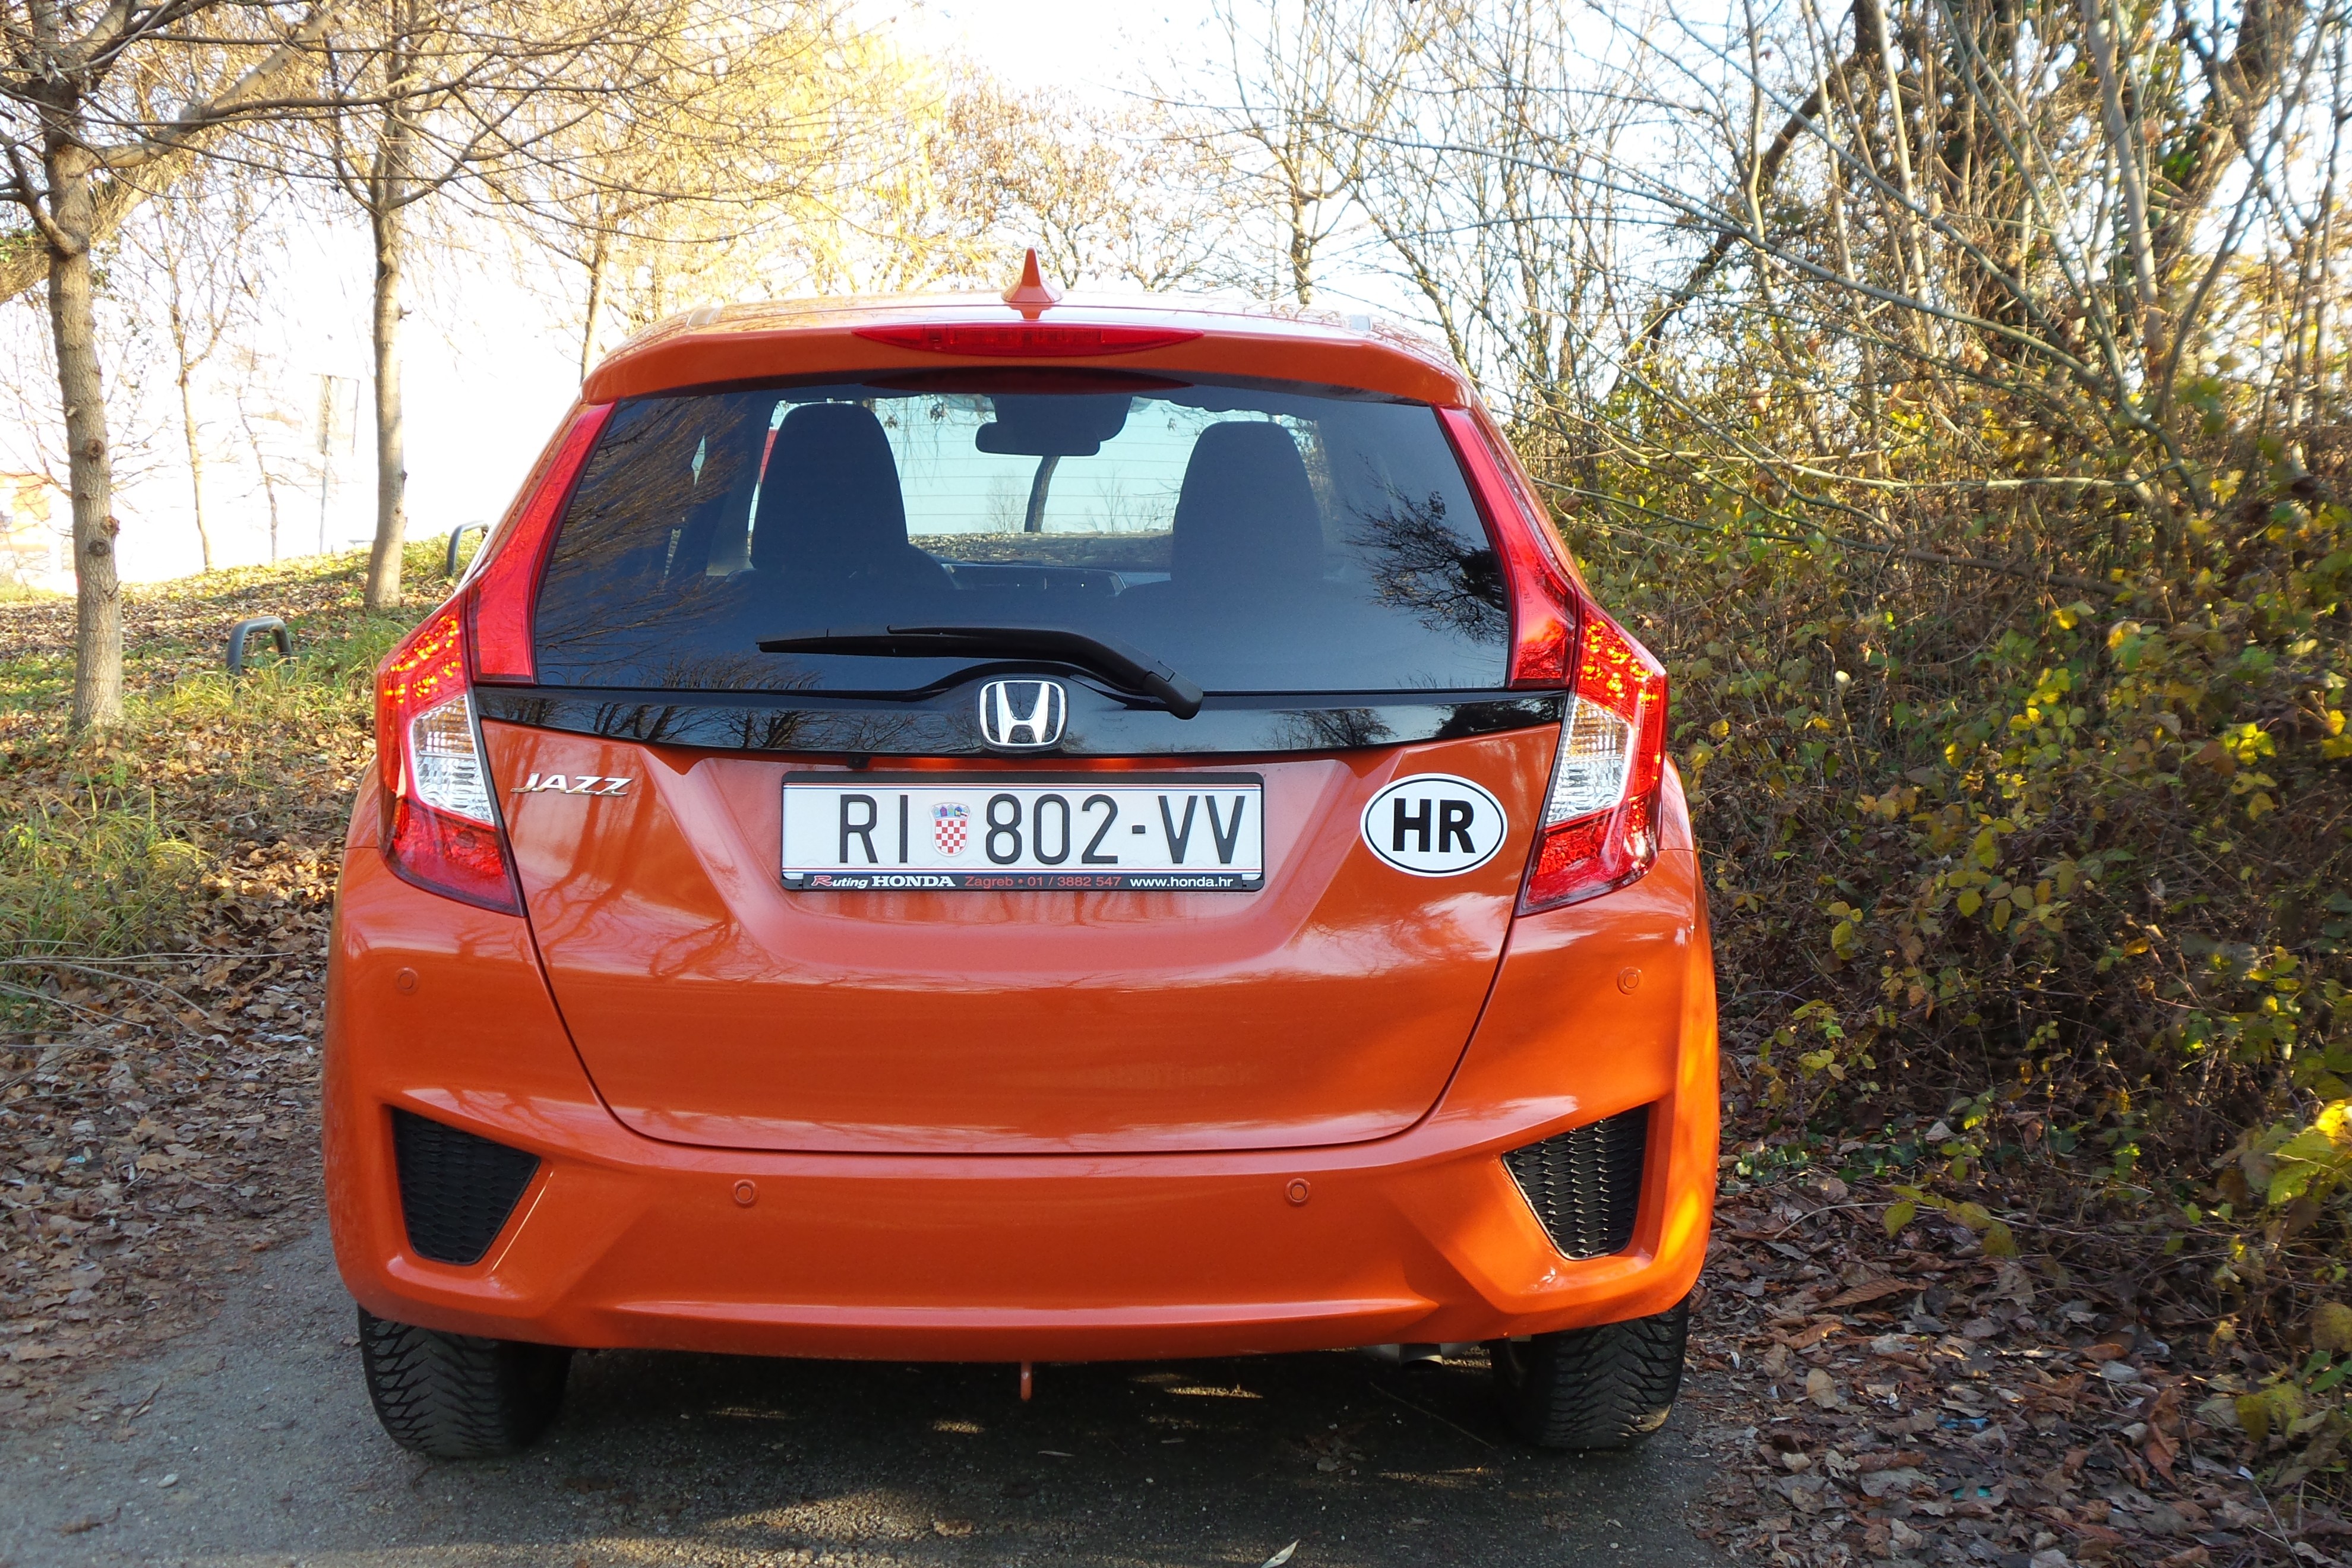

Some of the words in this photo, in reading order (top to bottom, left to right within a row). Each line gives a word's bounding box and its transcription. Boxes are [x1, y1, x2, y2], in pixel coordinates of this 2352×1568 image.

[510, 773, 633, 796] JAZZ
[839, 794, 908, 863] RI
[986, 794, 1245, 864] 802-VV
[1392, 798, 1477, 853] HR
[811, 875, 868, 889] Ruting
[871, 875, 956, 887] HONDA
[965, 876, 1014, 889] Zagreb
[1027, 877, 1042, 886] 01
[1057, 877, 1092, 887] 3882
[1095, 877, 1121, 886] 547
[1130, 876, 1234, 887] www.honda.hr
